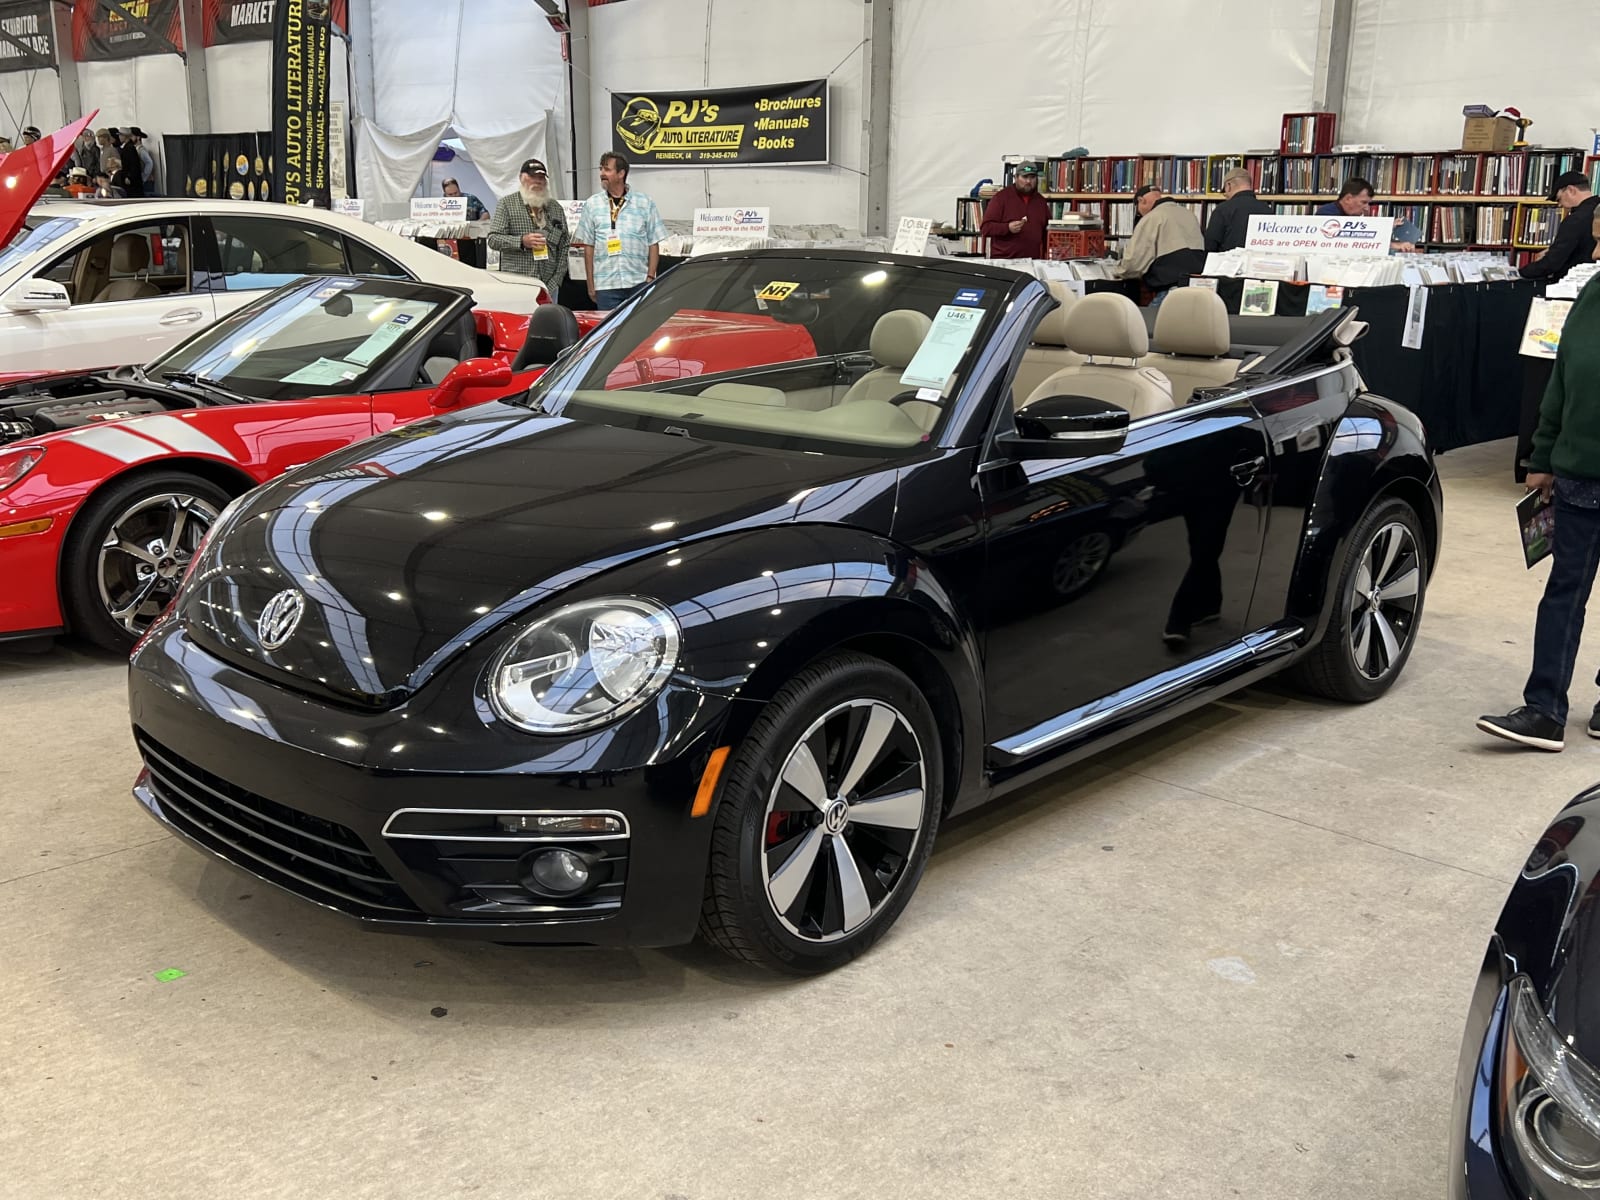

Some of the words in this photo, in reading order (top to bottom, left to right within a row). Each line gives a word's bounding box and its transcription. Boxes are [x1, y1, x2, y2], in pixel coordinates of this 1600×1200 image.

[231, 0, 275, 27] MARKET
[287, 0, 302, 113] LITERATUR
[306, 24, 315, 68] MANUALS
[306, 68, 314, 105] OWNERS
[317, 49, 326, 104] MAGAZINE
[662, 99, 720, 124] PJ's
[286, 115, 302, 169] AUTO
[305, 110, 314, 161] BROCHURES
[316, 110, 325, 160] MANUALS
[660, 130, 683, 144] AUTO
[685, 129, 740, 143] LITERATURE
[305, 162, 313, 188] SALES
[315, 160, 325, 189] SHOP
[1257, 221, 1303, 234] Welcome
[1305, 222, 1318, 234] to
[1342, 221, 1368, 230] PJ's
[1250, 238, 1274, 247] BAGS
[1276, 239, 1290, 247] are
[1292, 239, 1318, 248] OPEN
[1334, 240, 1349, 249] the
[1351, 240, 1382, 250] RIGHT
[762, 286, 792, 297] NR
